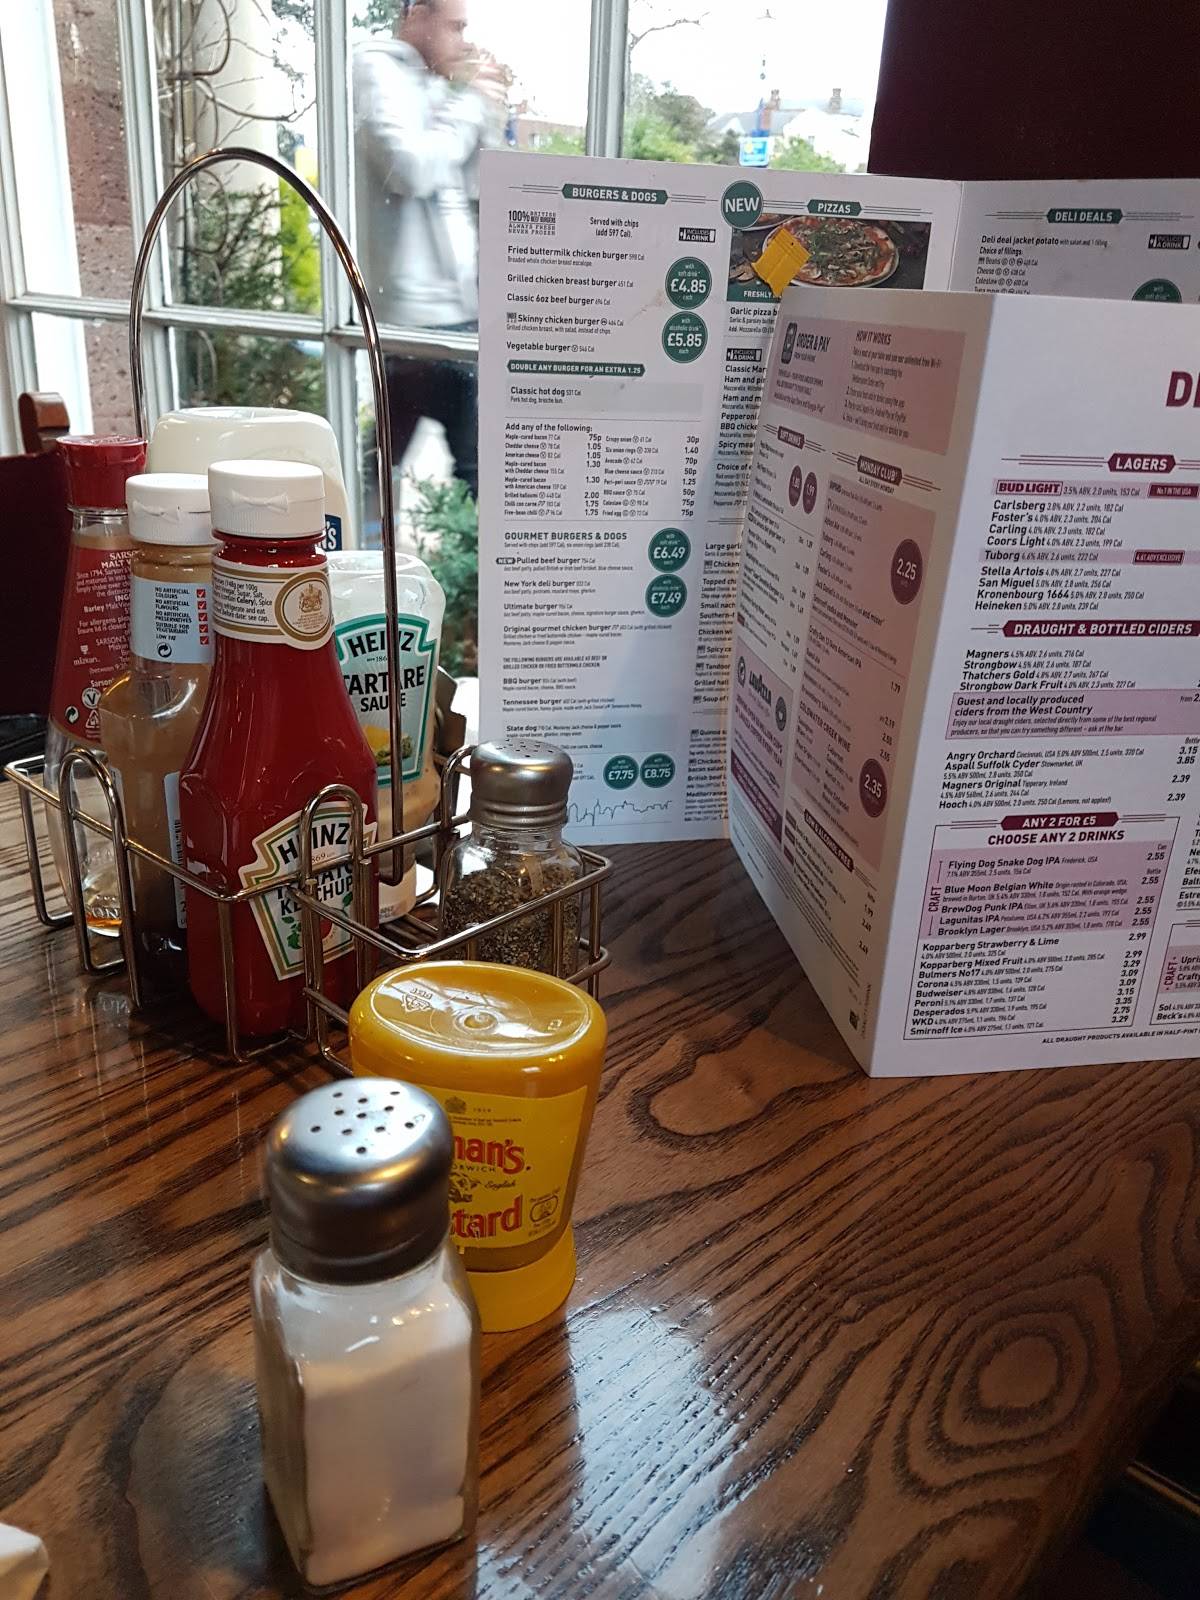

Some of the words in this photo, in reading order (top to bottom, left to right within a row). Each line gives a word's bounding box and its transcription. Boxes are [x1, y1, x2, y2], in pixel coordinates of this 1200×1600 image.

[572, 188, 620, 199] BURGERS
[622, 192, 630, 200] &
[632, 192, 657, 201] DOGS
[725, 198, 759, 212] NEW
[818, 203, 850, 214] PIZZAS
[509, 211, 529, 221] 100%
[1056, 212, 1077, 222] DELI
[1080, 212, 1112, 222] DEALS
[982, 236, 995, 244] Deli
[997, 236, 1011, 244] deal
[1013, 236, 1034, 245] jacket
[1036, 236, 1058, 246] potato
[508, 246, 528, 254] Fried
[530, 247, 570, 256] buttermilk
[573, 249, 600, 258] chicken
[602, 251, 628, 260] burger
[507, 274, 533, 284] Grilled
[536, 275, 563, 284] chicken
[566, 277, 590, 286] breast
[592, 279, 617, 287] burger
[671, 279, 706, 293] £4.85
[518, 315, 544, 324] Skinny
[545, 316, 573, 324] chicken
[575, 317, 599, 326] burger
[668, 333, 701, 348] £5.85
[507, 342, 543, 351] Vegetable
[545, 343, 570, 352] burger
[539, 387, 550, 395] hot
[552, 388, 565, 397] dog
[522, 424, 534, 432] any
[557, 424, 592, 433] following:
[589, 434, 601, 442] 75p
[1116, 457, 1167, 470] LAGERS
[999, 483, 1024, 492] BUD
[1026, 484, 1060, 492] LIGHT
[994, 500, 1046, 512] Carlsberg
[992, 512, 1033, 522] Foster's
[989, 524, 1027, 536] Carling
[988, 537, 1017, 546] Coors
[1020, 537, 1045, 548] Light
[654, 547, 685, 559] £6.49
[985, 551, 1020, 561] Tuborg
[102, 560, 123, 568] MALT
[558, 557, 580, 566] burger
[897, 558, 917, 581] 2.25
[981, 567, 1011, 576] Stella
[1013, 567, 1044, 576] Artois
[553, 580, 575, 589] burger
[979, 578, 998, 587] San
[1001, 578, 1034, 589] Miguel
[652, 593, 681, 604] £7.49
[977, 590, 1043, 600] Kronenbourg
[975, 602, 1022, 610] Heineken
[504, 625, 531, 633] Original
[532, 625, 560, 633] gourmet
[589, 624, 611, 632] burger
[1014, 624, 1075, 634] DRAUGHT
[1078, 625, 1086, 634] &
[1090, 624, 1146, 634] BOTTLED
[1148, 624, 1192, 634] CIDERS
[347, 631, 414, 657] HEIZ
[966, 650, 1009, 660] Magners
[964, 660, 1017, 671] Strongbow
[344, 665, 424, 695] ARTRE
[962, 671, 1011, 679] Thatchers
[1013, 671, 1035, 679] Gold
[960, 682, 1012, 692] Strongbow
[1014, 681, 1037, 690] Dark
[1040, 680, 1062, 689] Fruit
[361, 693, 406, 712] SAUE
[957, 696, 985, 706] Guest
[987, 696, 1004, 705] and
[1006, 696, 1038, 706] locally
[1040, 695, 1084, 705] produced
[955, 708, 984, 716] ciders
[986, 707, 1010, 715] from
[1012, 707, 1027, 715] the
[1029, 706, 1052, 714] West
[1054, 705, 1092, 716] Country
[1180, 746, 1197, 754] 3.15
[947, 752, 976, 762] Angry
[978, 750, 1015, 759] Orchard
[609, 770, 633, 780] £7.75
[645, 768, 670, 778] £8.75
[1172, 775, 1190, 783] 2.39
[864, 774, 882, 797] 2.35
[939, 800, 967, 808] Hooch
[1023, 818, 1046, 828] ANY
[1049, 818, 1057, 826] 2
[1059, 817, 1079, 826] FOR
[1083, 817, 1096, 825] £5
[988, 834, 1037, 845] CHOOSE
[1040, 833, 1065, 842] ANY
[1069, 832, 1076, 841] 2
[1079, 830, 1124, 841] DRINKS
[278, 823, 350, 864] HINZ
[949, 861, 976, 870] Flying
[978, 860, 996, 869] Dog
[998, 859, 1024, 867] Snake
[1027, 858, 1043, 867] Dog
[1046, 857, 1060, 865] IPA
[994, 884, 1026, 892] Belgian
[1029, 882, 1053, 890] White
[928, 887, 941, 912] CRAFT
[942, 905, 982, 913] BrewDog
[923, 943, 975, 951] Kopparberg
[914, 1009, 964, 1017] Desperados
[911, 1027, 948, 1035] Smirnoff
